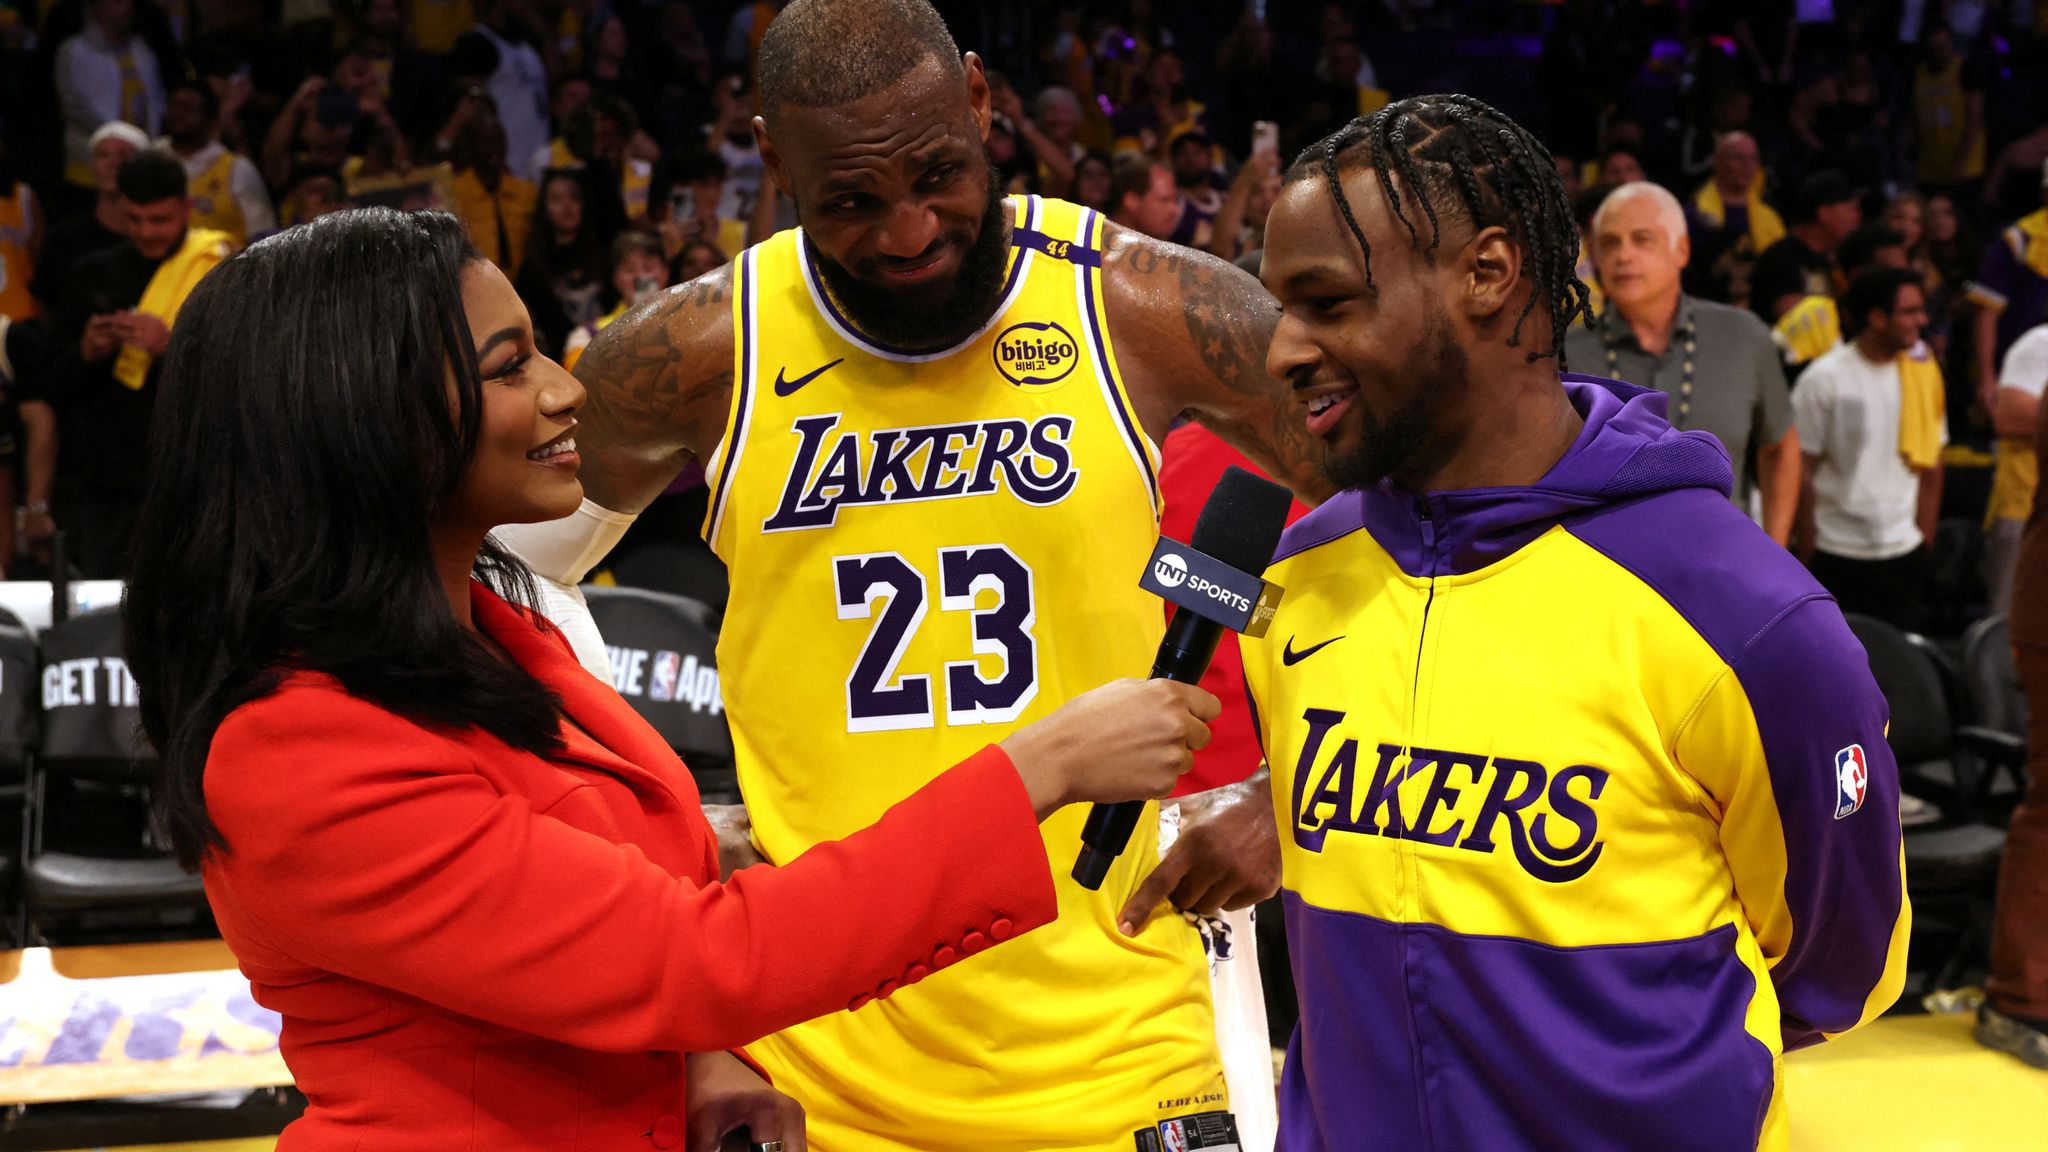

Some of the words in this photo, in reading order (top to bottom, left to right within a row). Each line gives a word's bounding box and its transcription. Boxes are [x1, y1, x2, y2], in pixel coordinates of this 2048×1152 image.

[1046, 240, 1070, 257] 44
[1000, 338, 1073, 366] bibigo
[1015, 360, 1046, 372] 비비고
[761, 411, 1081, 535] LAKERS
[1155, 557, 1188, 584] TNT
[1187, 575, 1251, 612] SPORTS
[831, 543, 1039, 733] 23
[42, 656, 99, 710] GET
[605, 645, 649, 696] HE
[1291, 707, 1610, 883] LAKERS
